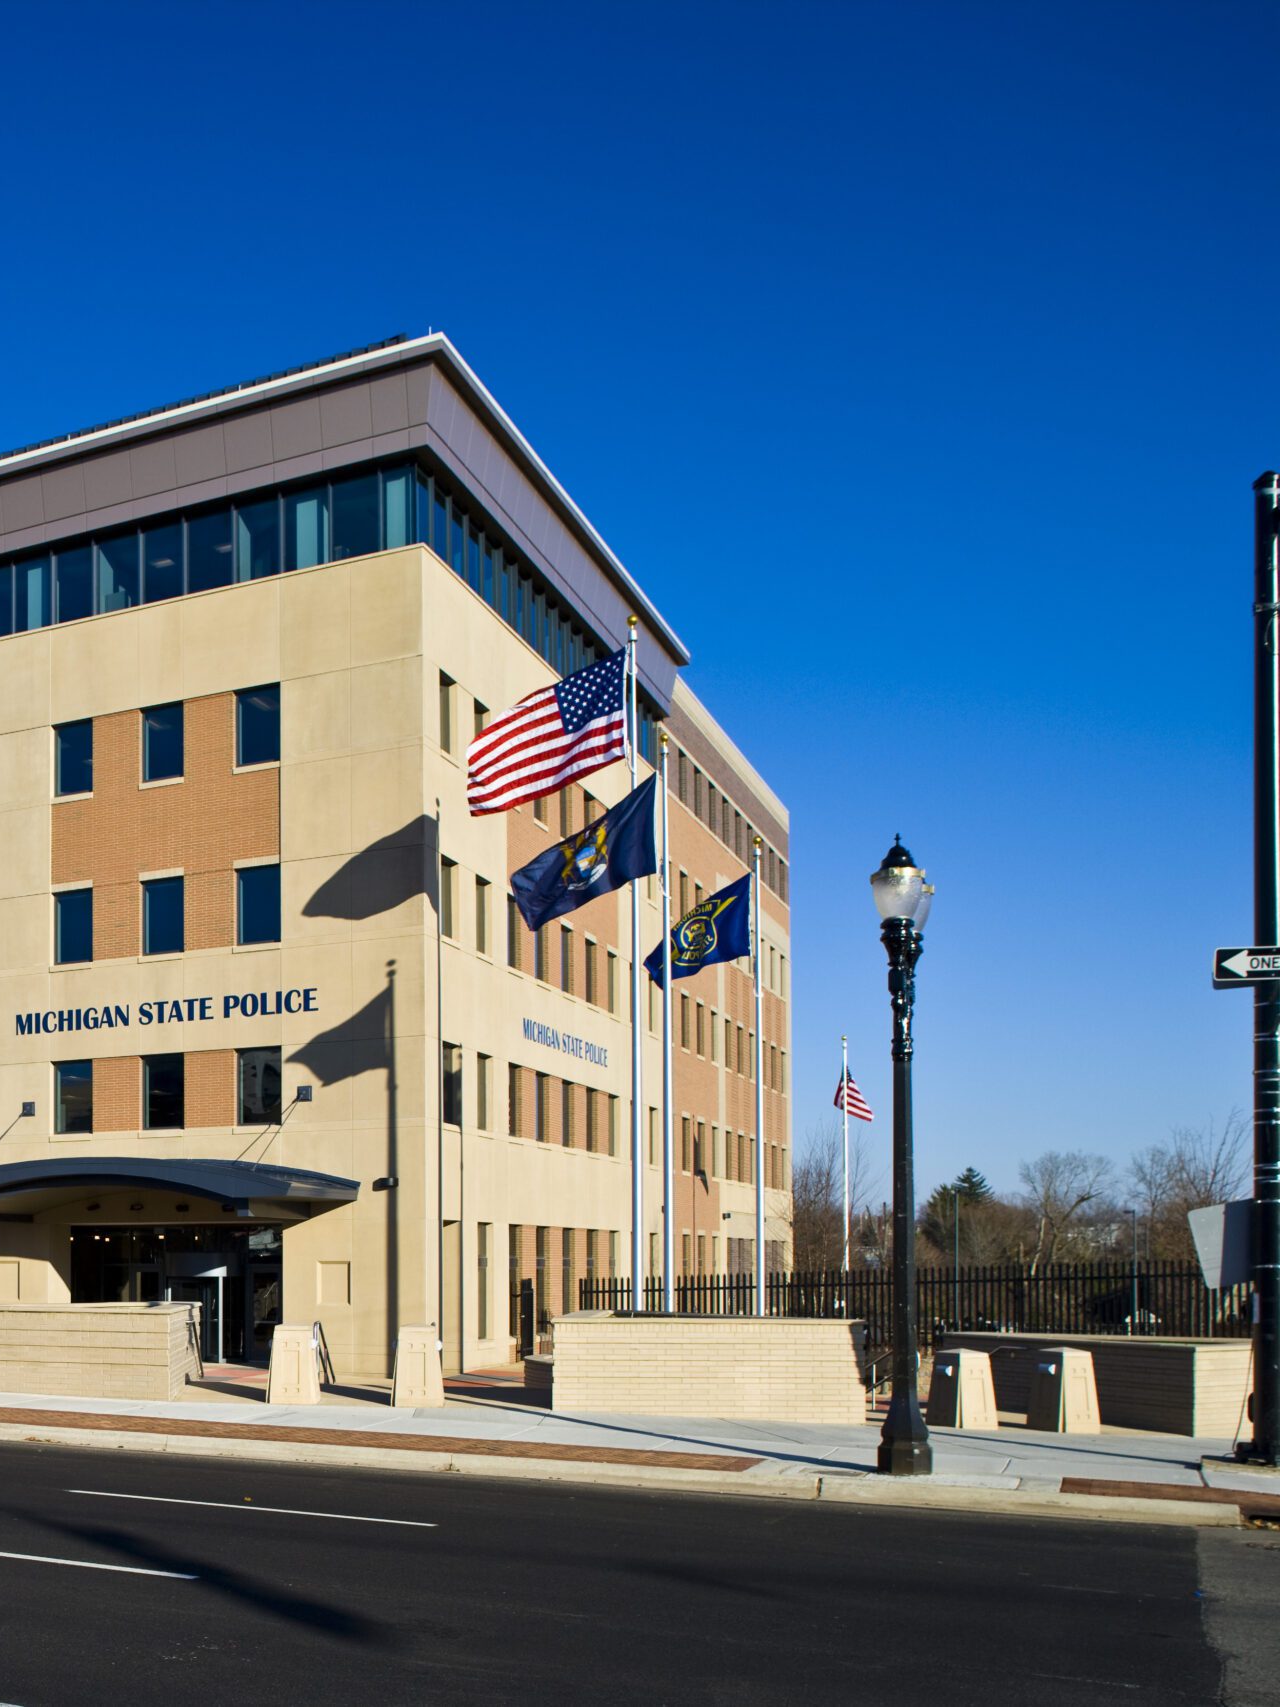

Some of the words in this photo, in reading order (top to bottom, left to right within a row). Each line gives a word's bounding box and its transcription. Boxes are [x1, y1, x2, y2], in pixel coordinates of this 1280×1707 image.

[1250, 956, 1280, 969] ONE
[15, 1004, 130, 1036] MICHIGAN
[138, 997, 214, 1026] STATE
[223, 987, 319, 1019] POLICE
[523, 1017, 560, 1050] MICHIGAN
[562, 1032, 583, 1059] STATE
[585, 1042, 608, 1067] POLICE
